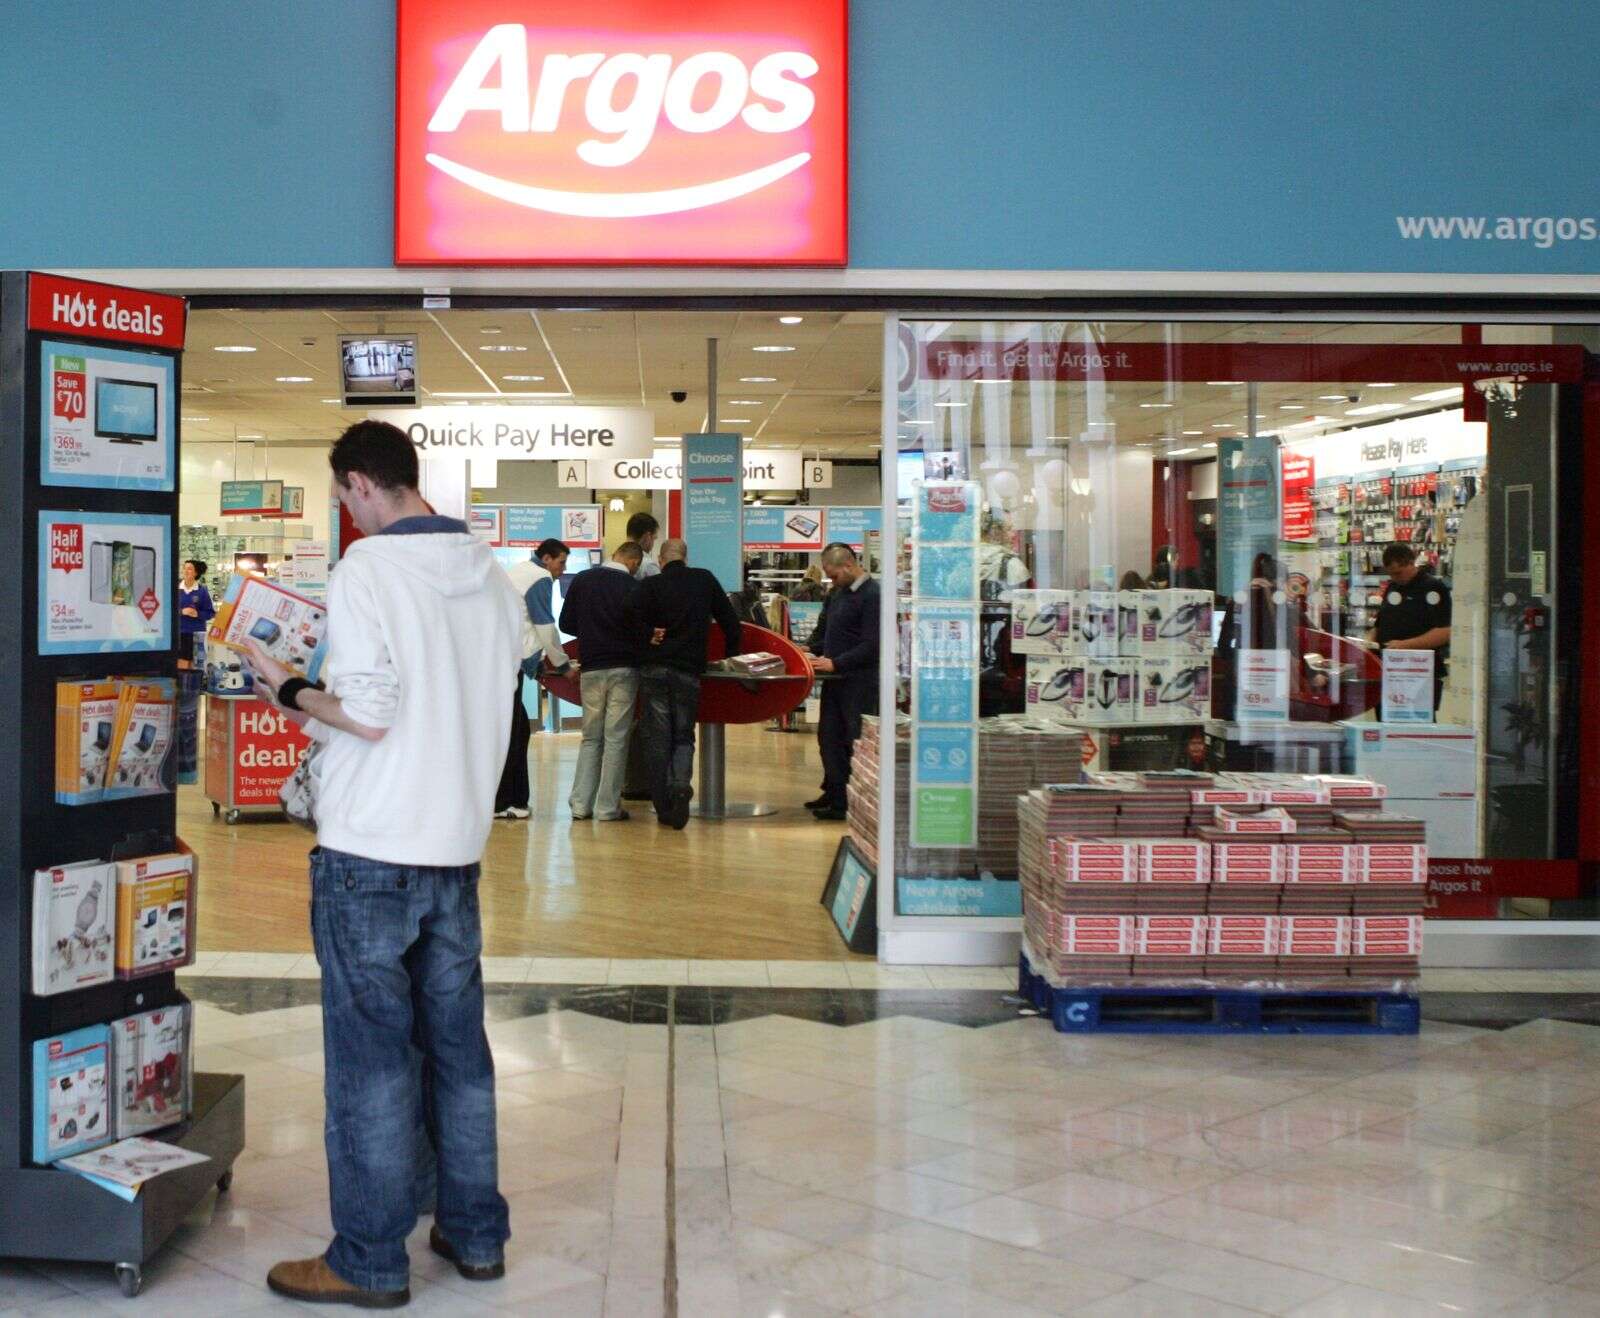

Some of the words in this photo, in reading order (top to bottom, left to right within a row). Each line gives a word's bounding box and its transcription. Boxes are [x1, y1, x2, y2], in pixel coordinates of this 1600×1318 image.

[427, 23, 819, 167] Argos
[1396, 216, 1600, 248] www.argos
[52, 291, 97, 328] Hot
[102, 299, 164, 336] deals
[60, 359, 80, 371] New
[937, 351, 975, 367] Find
[1003, 352, 1032, 368] Get
[1060, 352, 1111, 371] Argos
[1116, 352, 1132, 368] it.
[1456, 359, 1554, 375] www.argos.ie
[56, 375, 78, 389] Save
[56, 390, 83, 414] €70
[407, 421, 484, 450] Quick
[495, 423, 541, 453] Pay
[551, 423, 615, 447] Here
[688, 451, 735, 465] Choose
[1388, 437, 1403, 463] Pay
[566, 466, 578, 482] A
[613, 461, 683, 480] Collect
[742, 461, 776, 480] int
[812, 466, 824, 483] B
[52, 529, 79, 548] Half
[52, 548, 83, 565] Price
[240, 707, 289, 736] Hot
[240, 776, 257, 786] The
[239, 787, 263, 797] deals
[1428, 864, 1460, 875] oose
[1463, 862, 1493, 875] how
[943, 885, 984, 900] Argos
[1429, 879, 1469, 896] Argos
[1471, 879, 1482, 893] it
